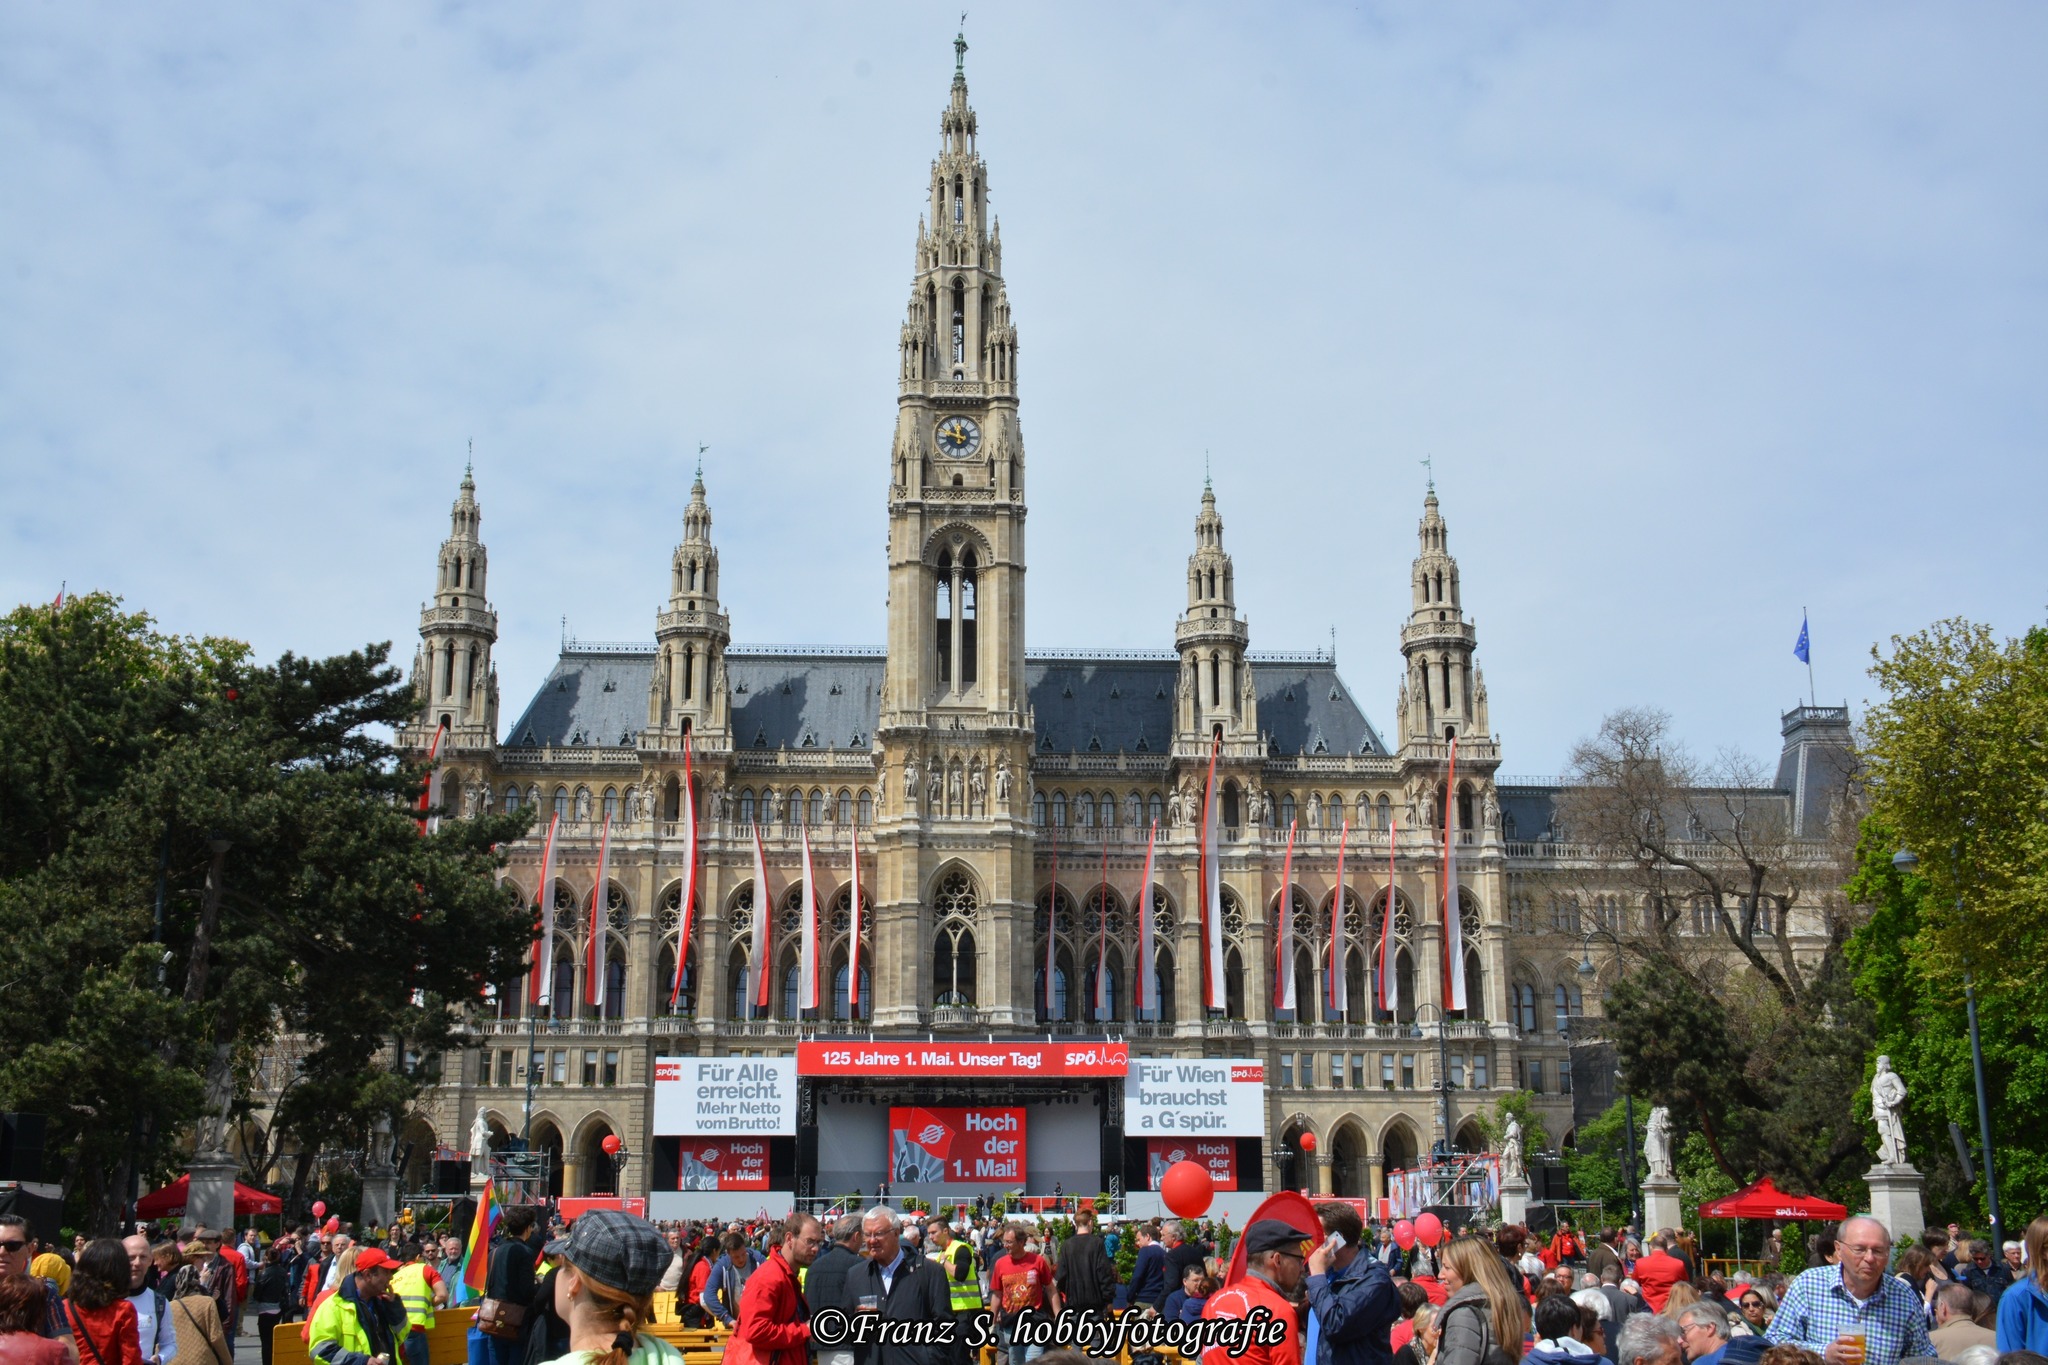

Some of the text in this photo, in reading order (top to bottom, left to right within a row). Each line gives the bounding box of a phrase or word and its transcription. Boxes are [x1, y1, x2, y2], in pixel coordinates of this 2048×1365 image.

[822, 1051, 1041, 1069] 125 Jahre 1. Mai. Unser Tag!
[1065, 1050, 1096, 1066] SPÖ
[656, 1067, 673, 1077] SPÖ
[698, 1063, 778, 1082] Für Alle
[1140, 1065, 1226, 1082] Für Wien
[1231, 1069, 1248, 1079] SPÖ
[697, 1082, 781, 1099] erreicht.
[1140, 1088, 1227, 1106] brauchst
[697, 1101, 781, 1114] Mehr Netto
[966, 1113, 1017, 1131] Hoch
[1141, 1115, 1154, 1129] a
[730, 1143, 763, 1154] Hoch
[984, 1136, 1018, 1154] der
[1197, 1144, 1229, 1155] Hoch
[741, 1156, 763, 1167] der
[953, 1159, 1017, 1177] 1. Mai!
[1208, 1157, 1230, 1168] der
[722, 1169, 762, 1181] 1. Mai!
